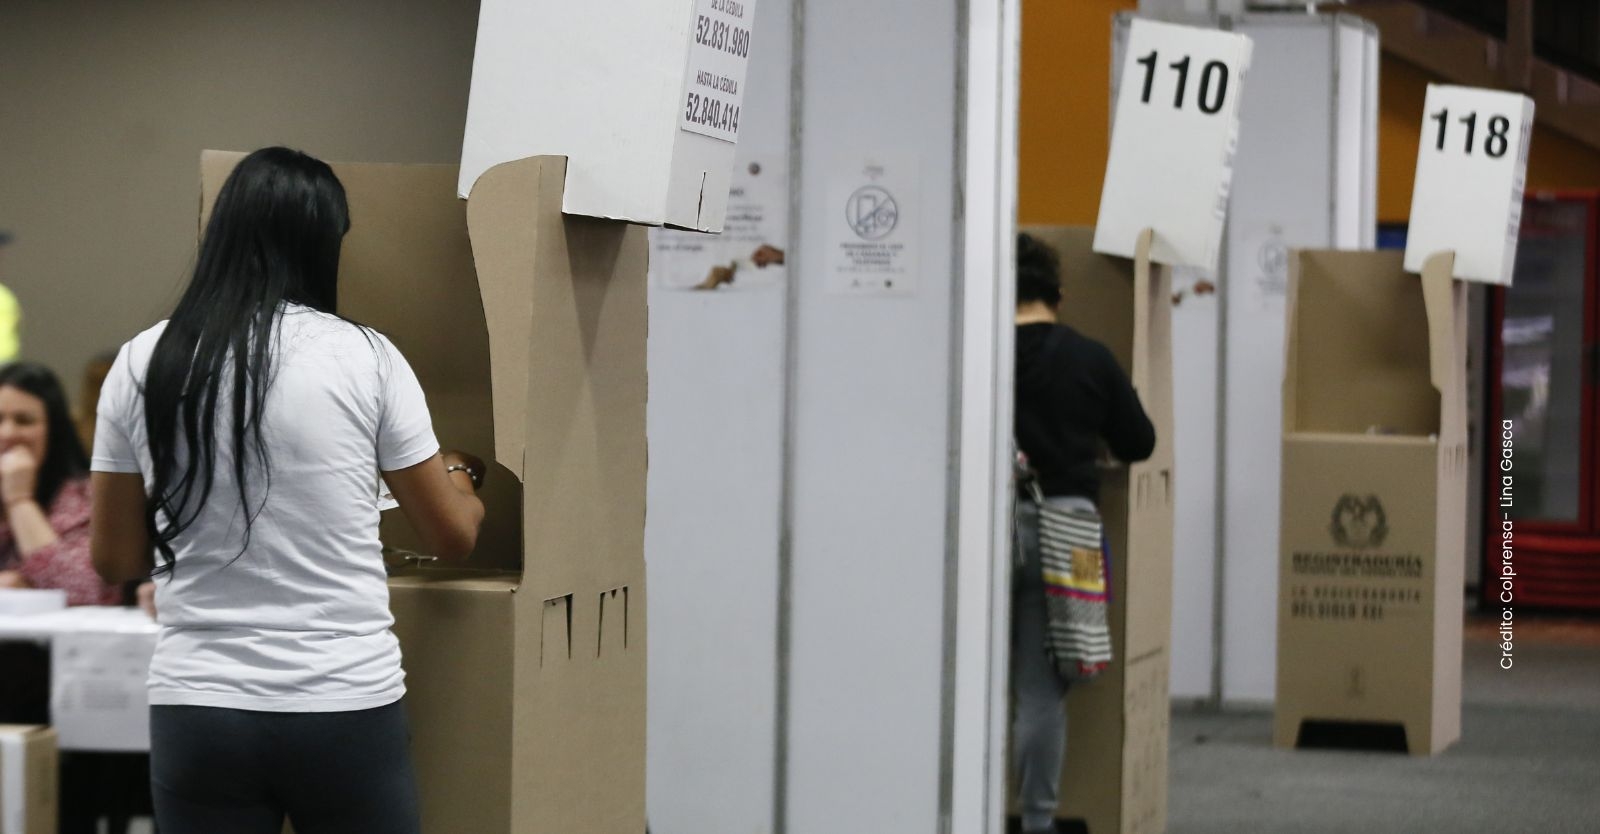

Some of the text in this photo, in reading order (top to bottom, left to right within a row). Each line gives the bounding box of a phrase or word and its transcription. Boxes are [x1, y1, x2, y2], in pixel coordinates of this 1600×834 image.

[696, 15, 750, 58] 52.831.980
[696, 70, 738, 95] HASTA LA CÉDULA
[1136, 49, 1230, 115] 110
[685, 92, 740, 133] 52.840.414
[1430, 107, 1511, 160] 118
